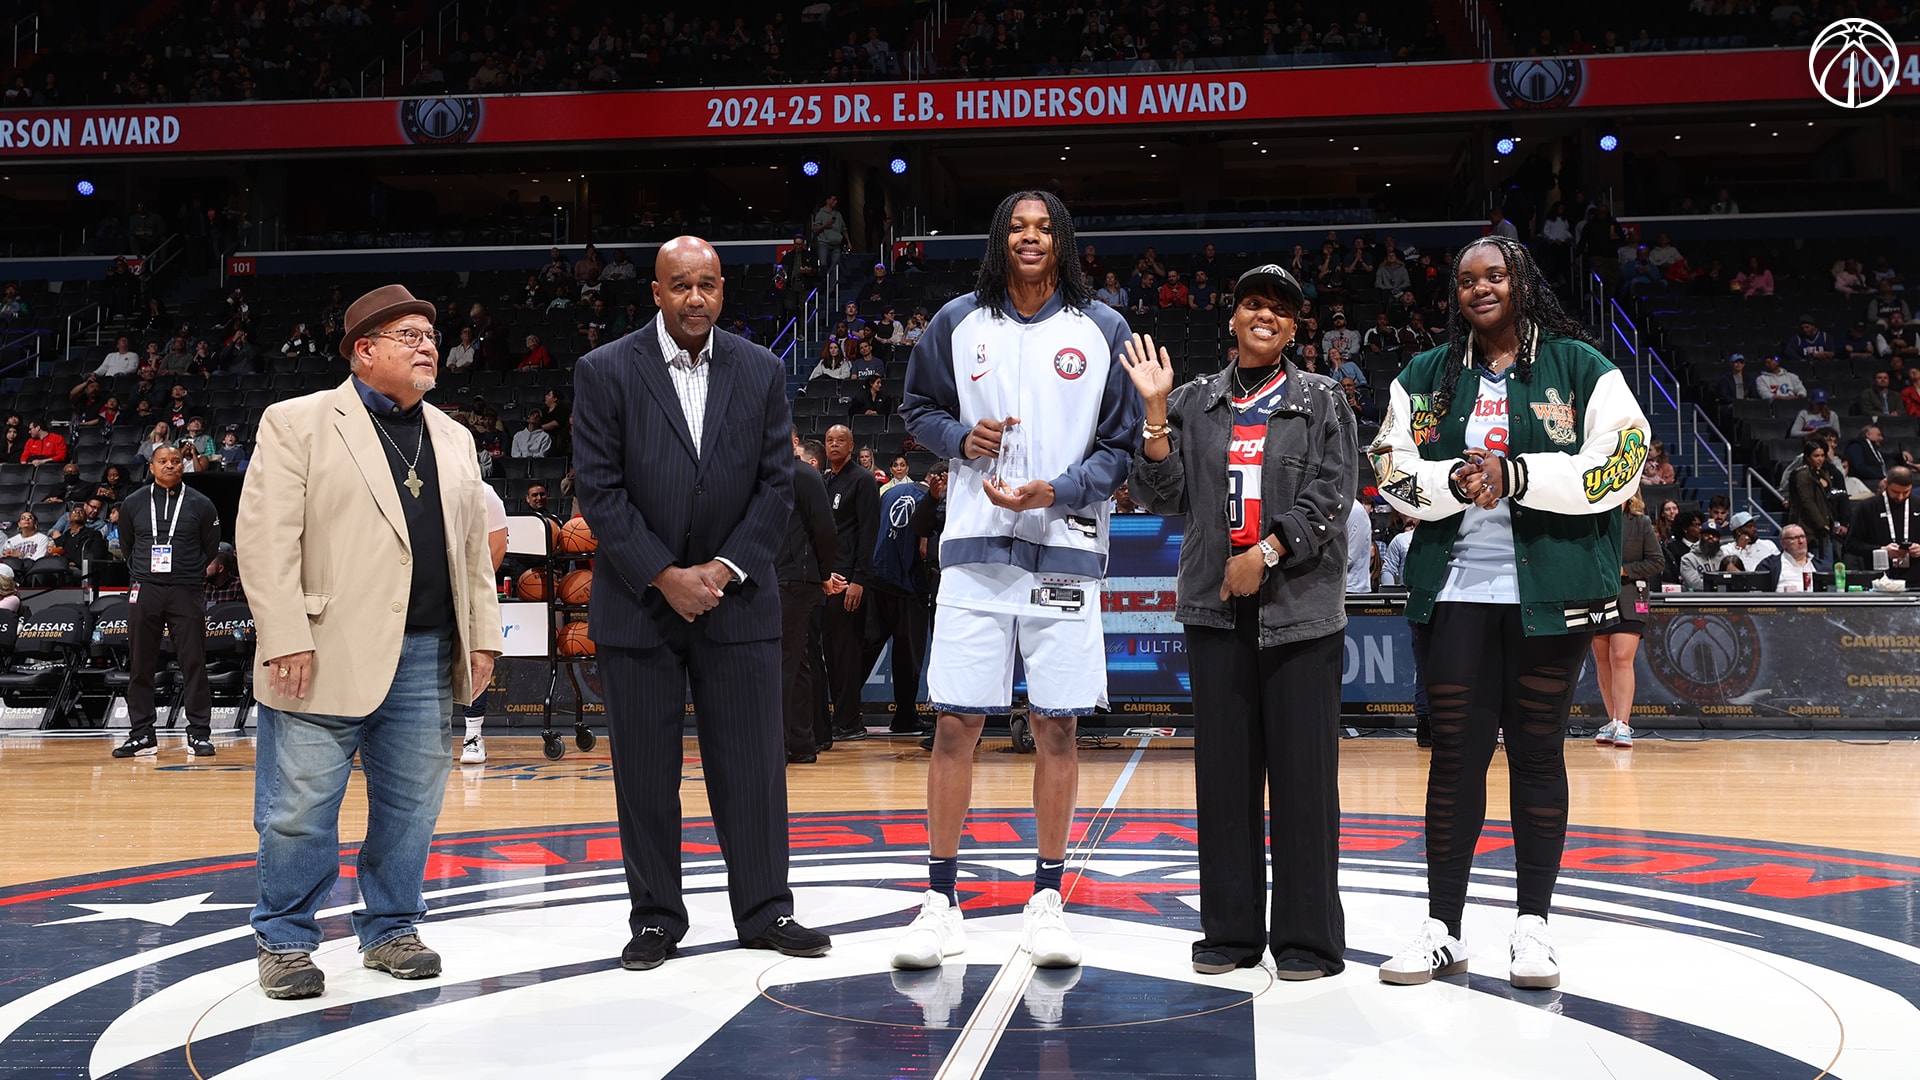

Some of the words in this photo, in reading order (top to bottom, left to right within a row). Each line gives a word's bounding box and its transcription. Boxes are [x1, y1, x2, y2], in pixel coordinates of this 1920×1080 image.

[707, 96, 822, 127] 2024-25
[834, 93, 881, 124] DR.
[893, 92, 944, 122] E.B.
[956, 86, 1127, 120] HENDERSON
[1138, 81, 1247, 115] AWARD
[0, 118, 71, 148] RSON
[80, 116, 180, 146] AWARD
[128, 265, 142, 276] 02
[232, 262, 251, 273] 101
[22, 622, 75, 632] CAESARS
[99, 619, 128, 629] CAES
[207, 618, 254, 631] CAEAR
